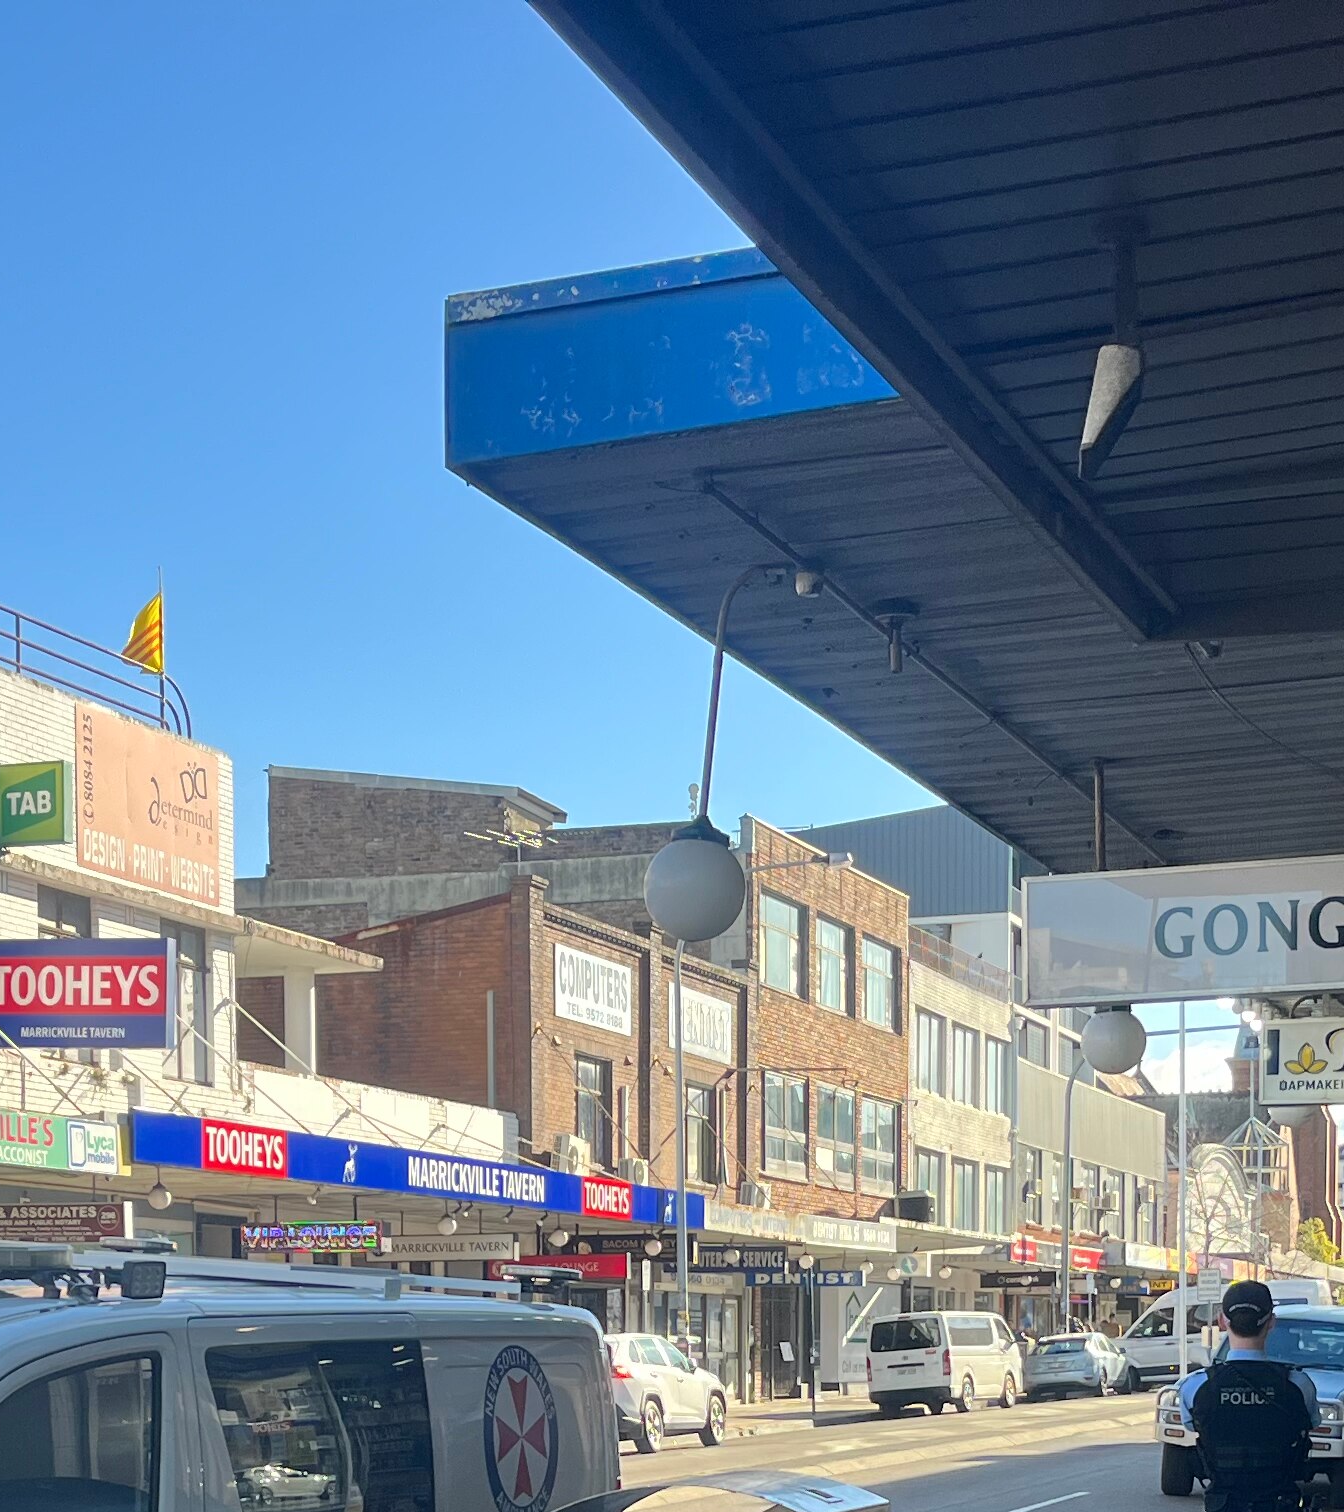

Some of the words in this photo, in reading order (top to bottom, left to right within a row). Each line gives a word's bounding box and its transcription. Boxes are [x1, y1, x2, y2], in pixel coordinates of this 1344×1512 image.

[82, 713, 94, 757] 2125
[6, 790, 52, 816] TAB
[83, 828, 126, 873] DESIGN
[133, 844, 165, 884] PRINT
[170, 855, 215, 899] WEBSITE
[558, 951, 628, 1014] COMPUTERS
[20, 1026, 88, 1039] MARRICKVILLE
[89, 1027, 126, 1039] TAVERN
[87, 1130, 115, 1154] Lyca
[205, 1125, 284, 1170] TOOHEYS
[87, 1151, 116, 1166] mobile
[407, 1156, 500, 1197] MARRICKVILLE
[500, 1169, 545, 1203] TAVERN
[583, 1181, 630, 1215] TOOHEYS
[10, 1205, 97, 1219] ASSOCIATES
[390, 1241, 466, 1254] MARRICKVILLE
[468, 1240, 510, 1253] TAVERN
[743, 1251, 784, 1268] SERVICE
[485, 1369, 501, 1417] NEW
[496, 1348, 529, 1375] SOUTH
[529, 1362, 556, 1420] WALES
[1220, 1391, 1275, 1405] POLIC
